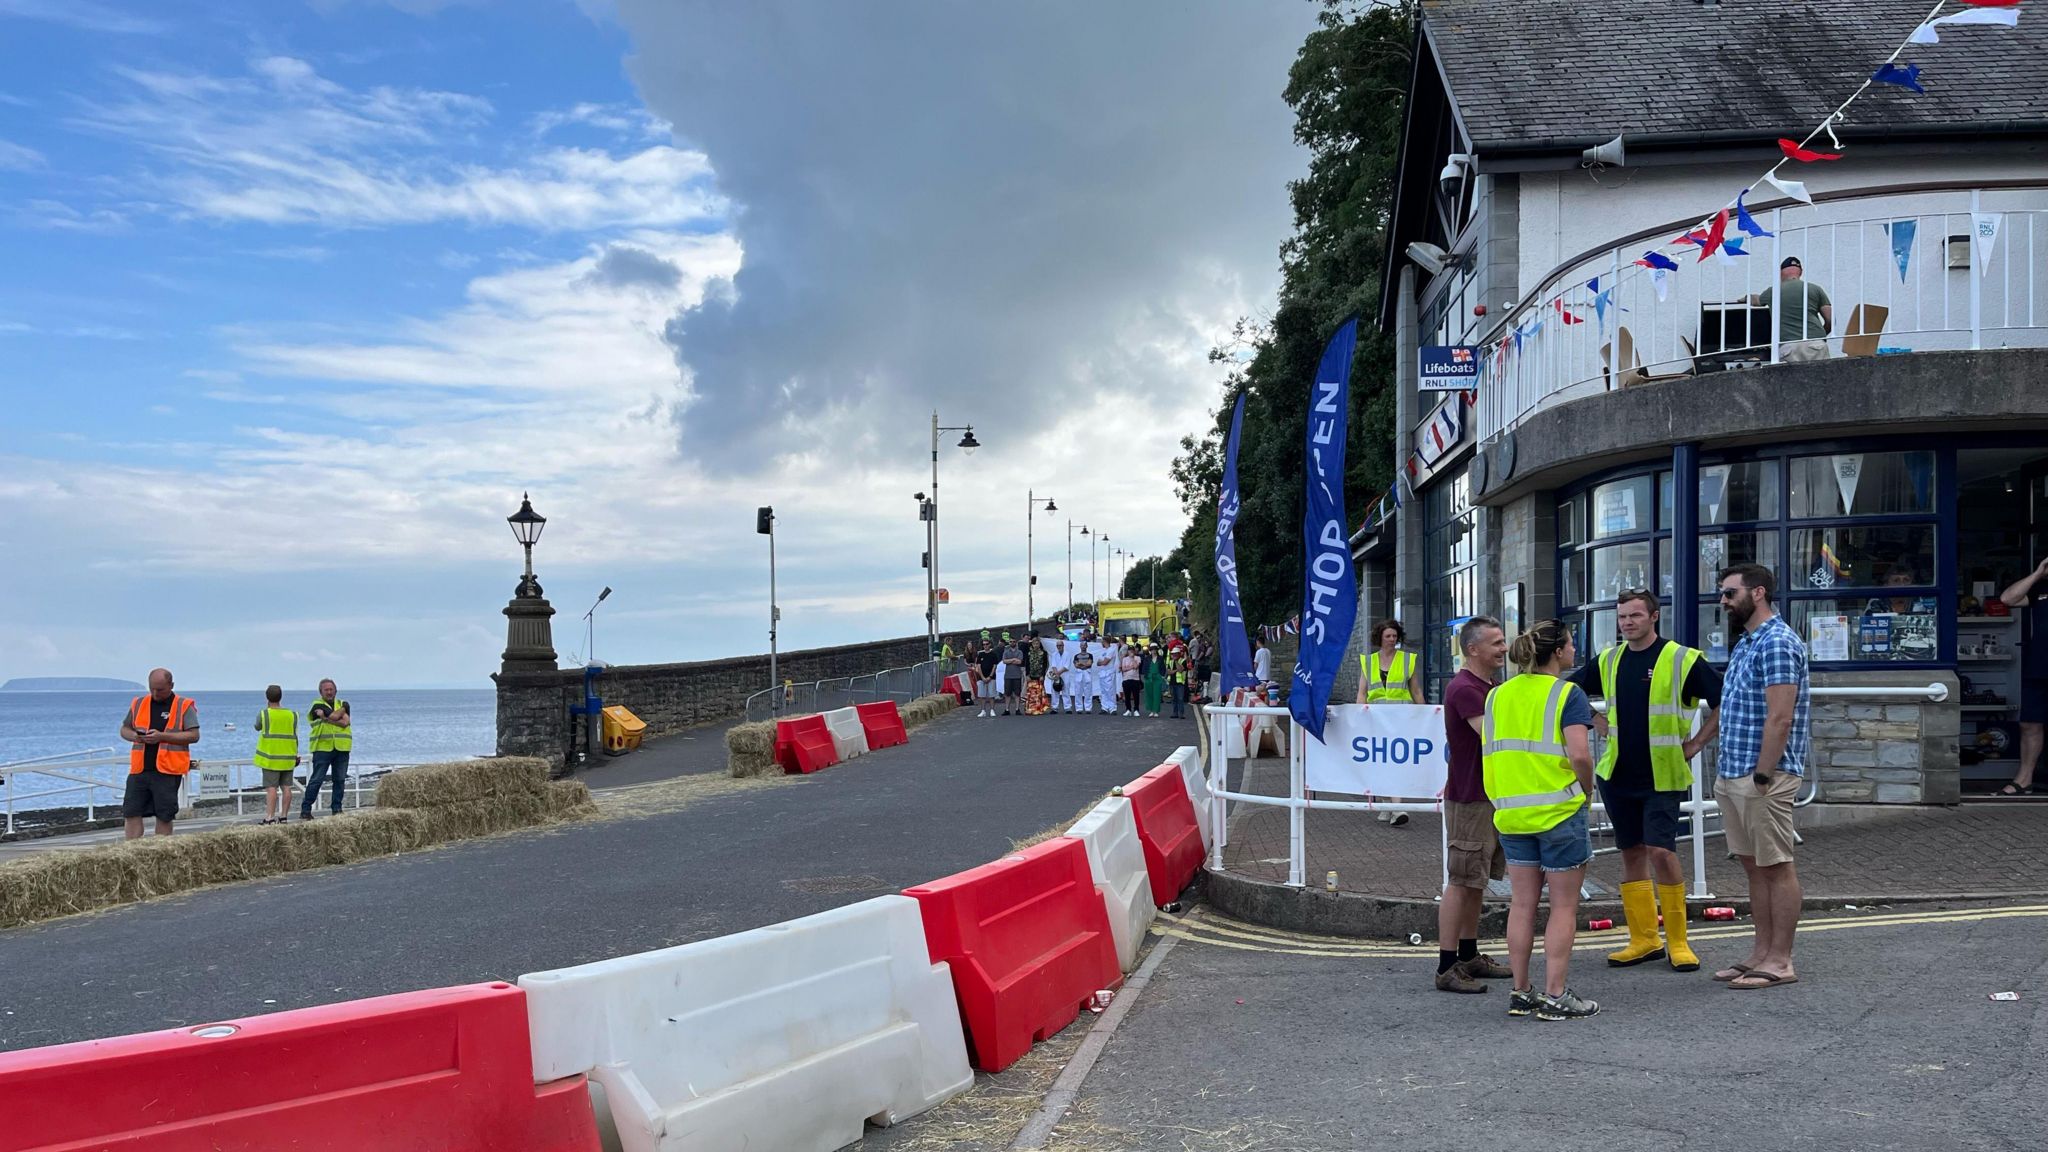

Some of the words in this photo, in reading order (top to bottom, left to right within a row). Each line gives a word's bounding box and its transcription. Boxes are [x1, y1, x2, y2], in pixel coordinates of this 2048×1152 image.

[1425, 362, 1474, 374] Lifeboats
[1425, 379, 1447, 388] RNLI
[1449, 378, 1475, 387] SHOP
[1312, 382, 1340, 506] EN
[1306, 519, 1346, 646] SHOP
[1815, 567, 1835, 586] RNLI
[1351, 736, 1434, 765] SHOP
[202, 773, 228, 783] Warning
